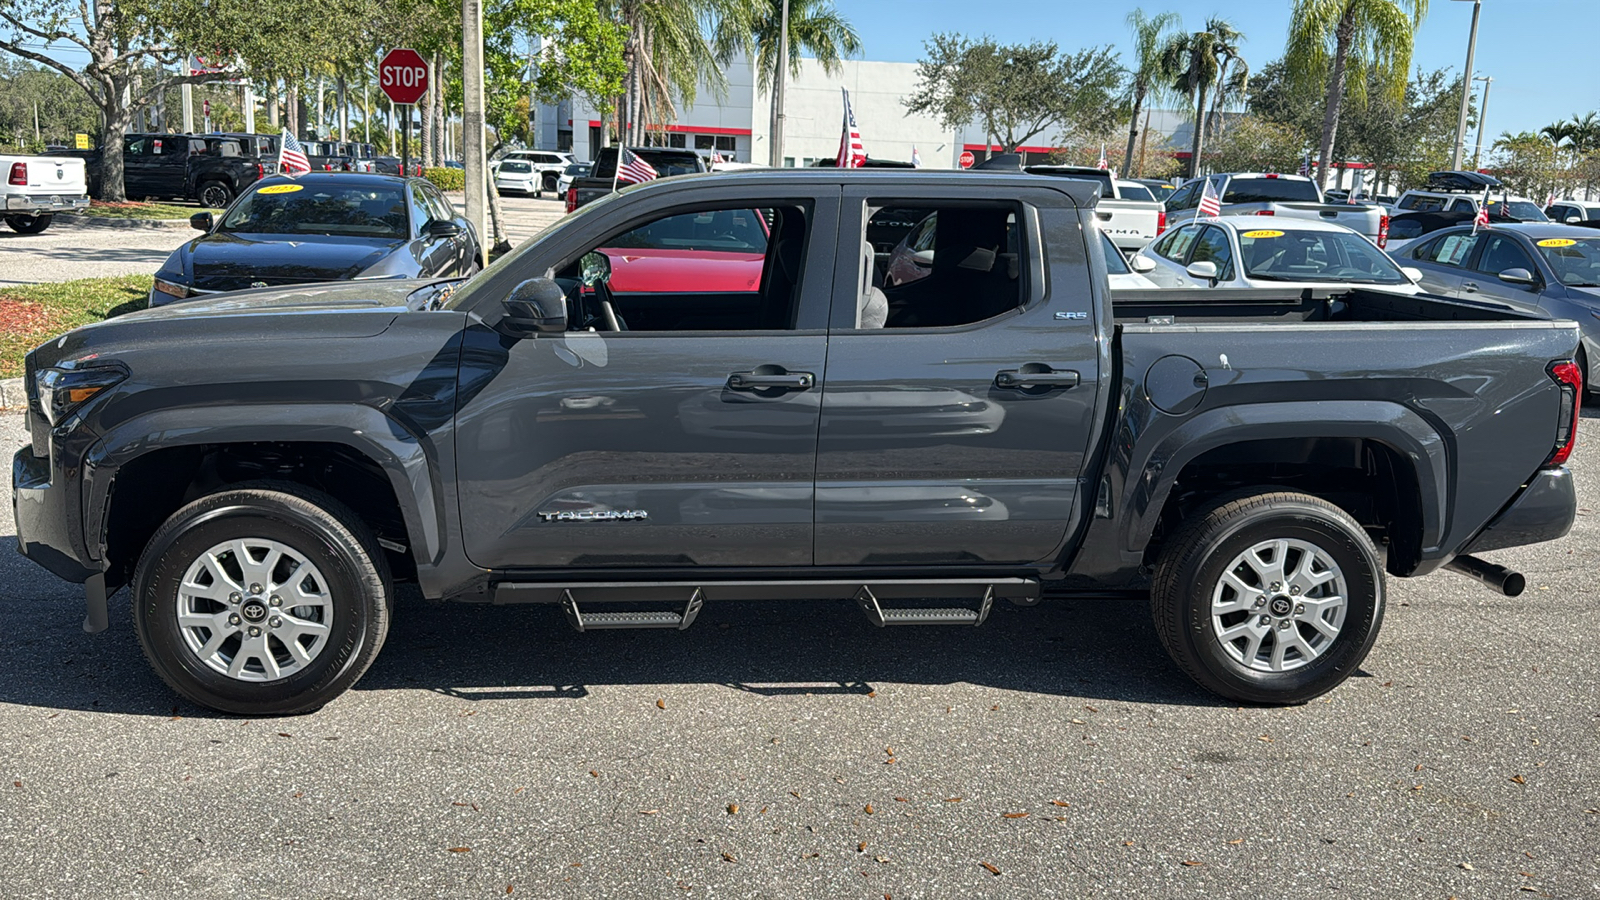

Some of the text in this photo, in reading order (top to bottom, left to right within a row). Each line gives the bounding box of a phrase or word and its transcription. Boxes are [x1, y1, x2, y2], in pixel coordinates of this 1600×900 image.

[382, 65, 426, 87] STOP
[960, 155, 974, 164] STOP
[1053, 311, 1088, 320] SR5
[537, 510, 648, 521] TACOMA
